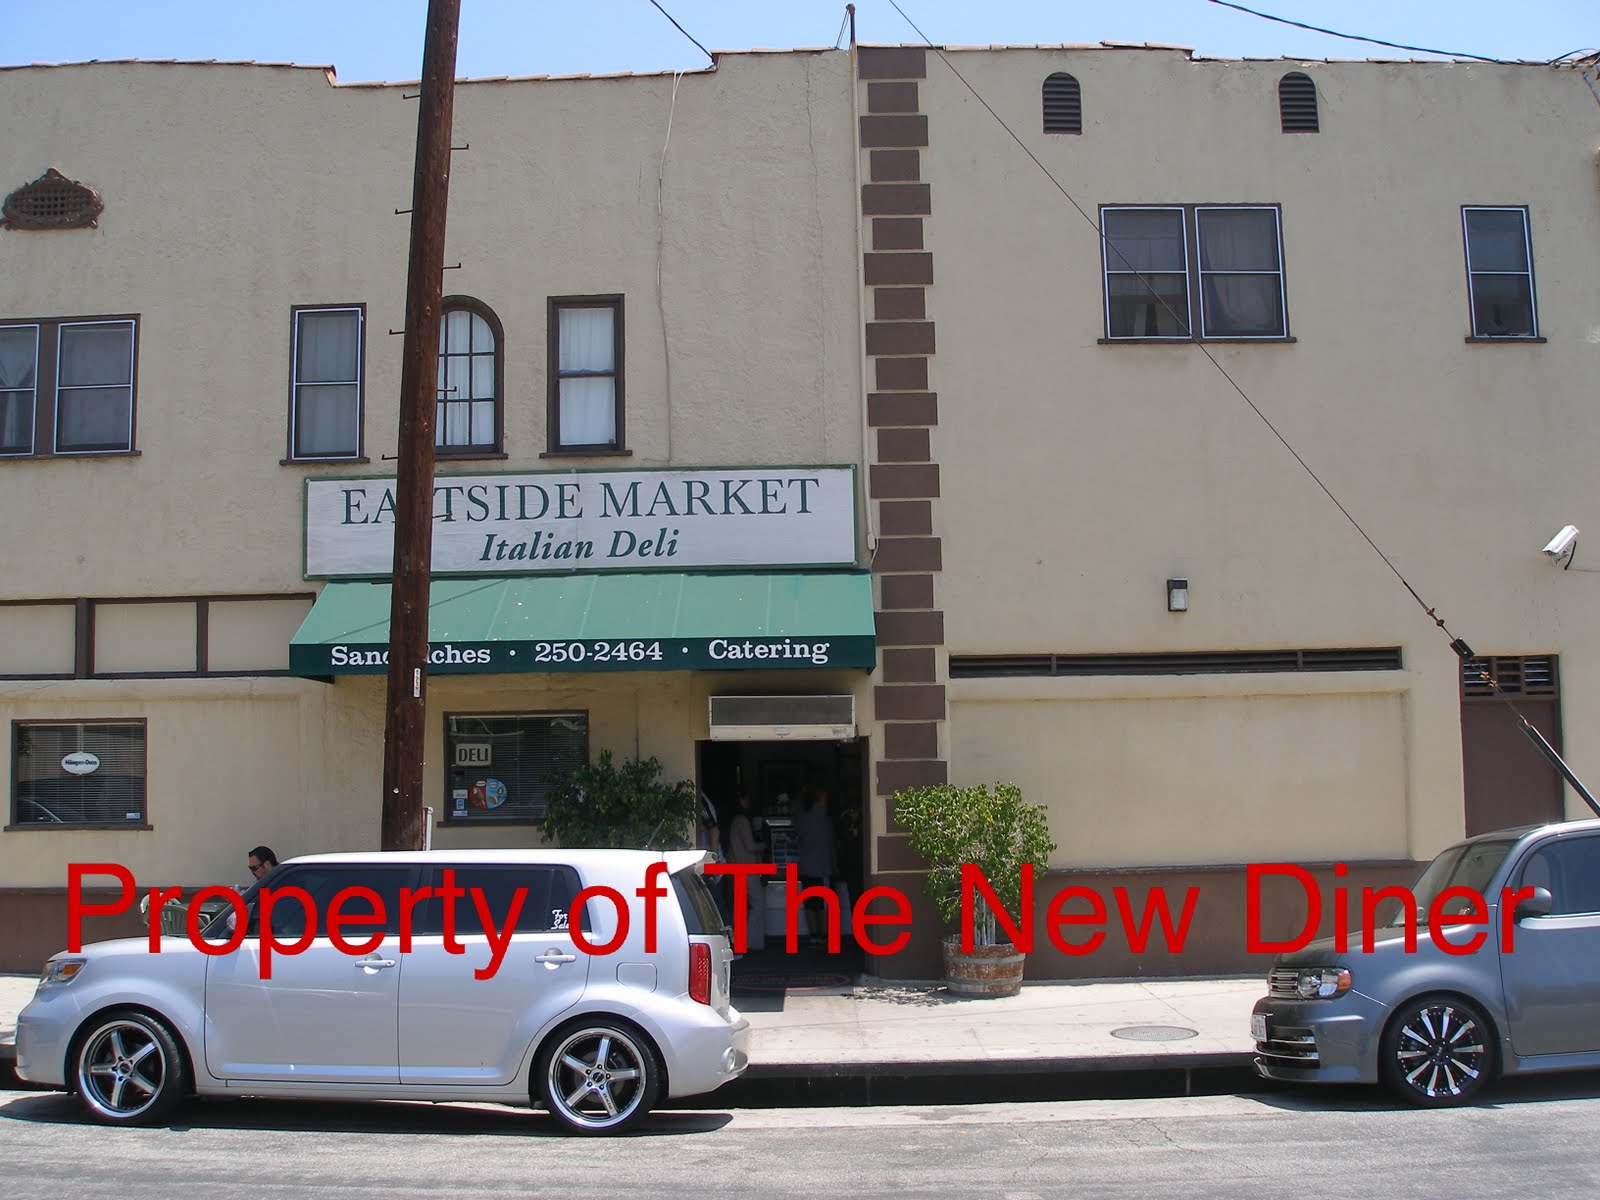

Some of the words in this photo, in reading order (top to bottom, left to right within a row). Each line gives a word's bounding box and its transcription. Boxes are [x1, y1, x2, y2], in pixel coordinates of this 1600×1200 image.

[341, 483, 584, 525] EATSIDE
[599, 477, 820, 518] MARKET
[479, 530, 594, 562] Italian
[606, 527, 680, 559] Deli
[331, 645, 491, 666] Sanches
[534, 641, 663, 662] 250-2464
[708, 638, 830, 665] Catering
[458, 748, 489, 762] DELI
[551, 909, 568, 920] For
